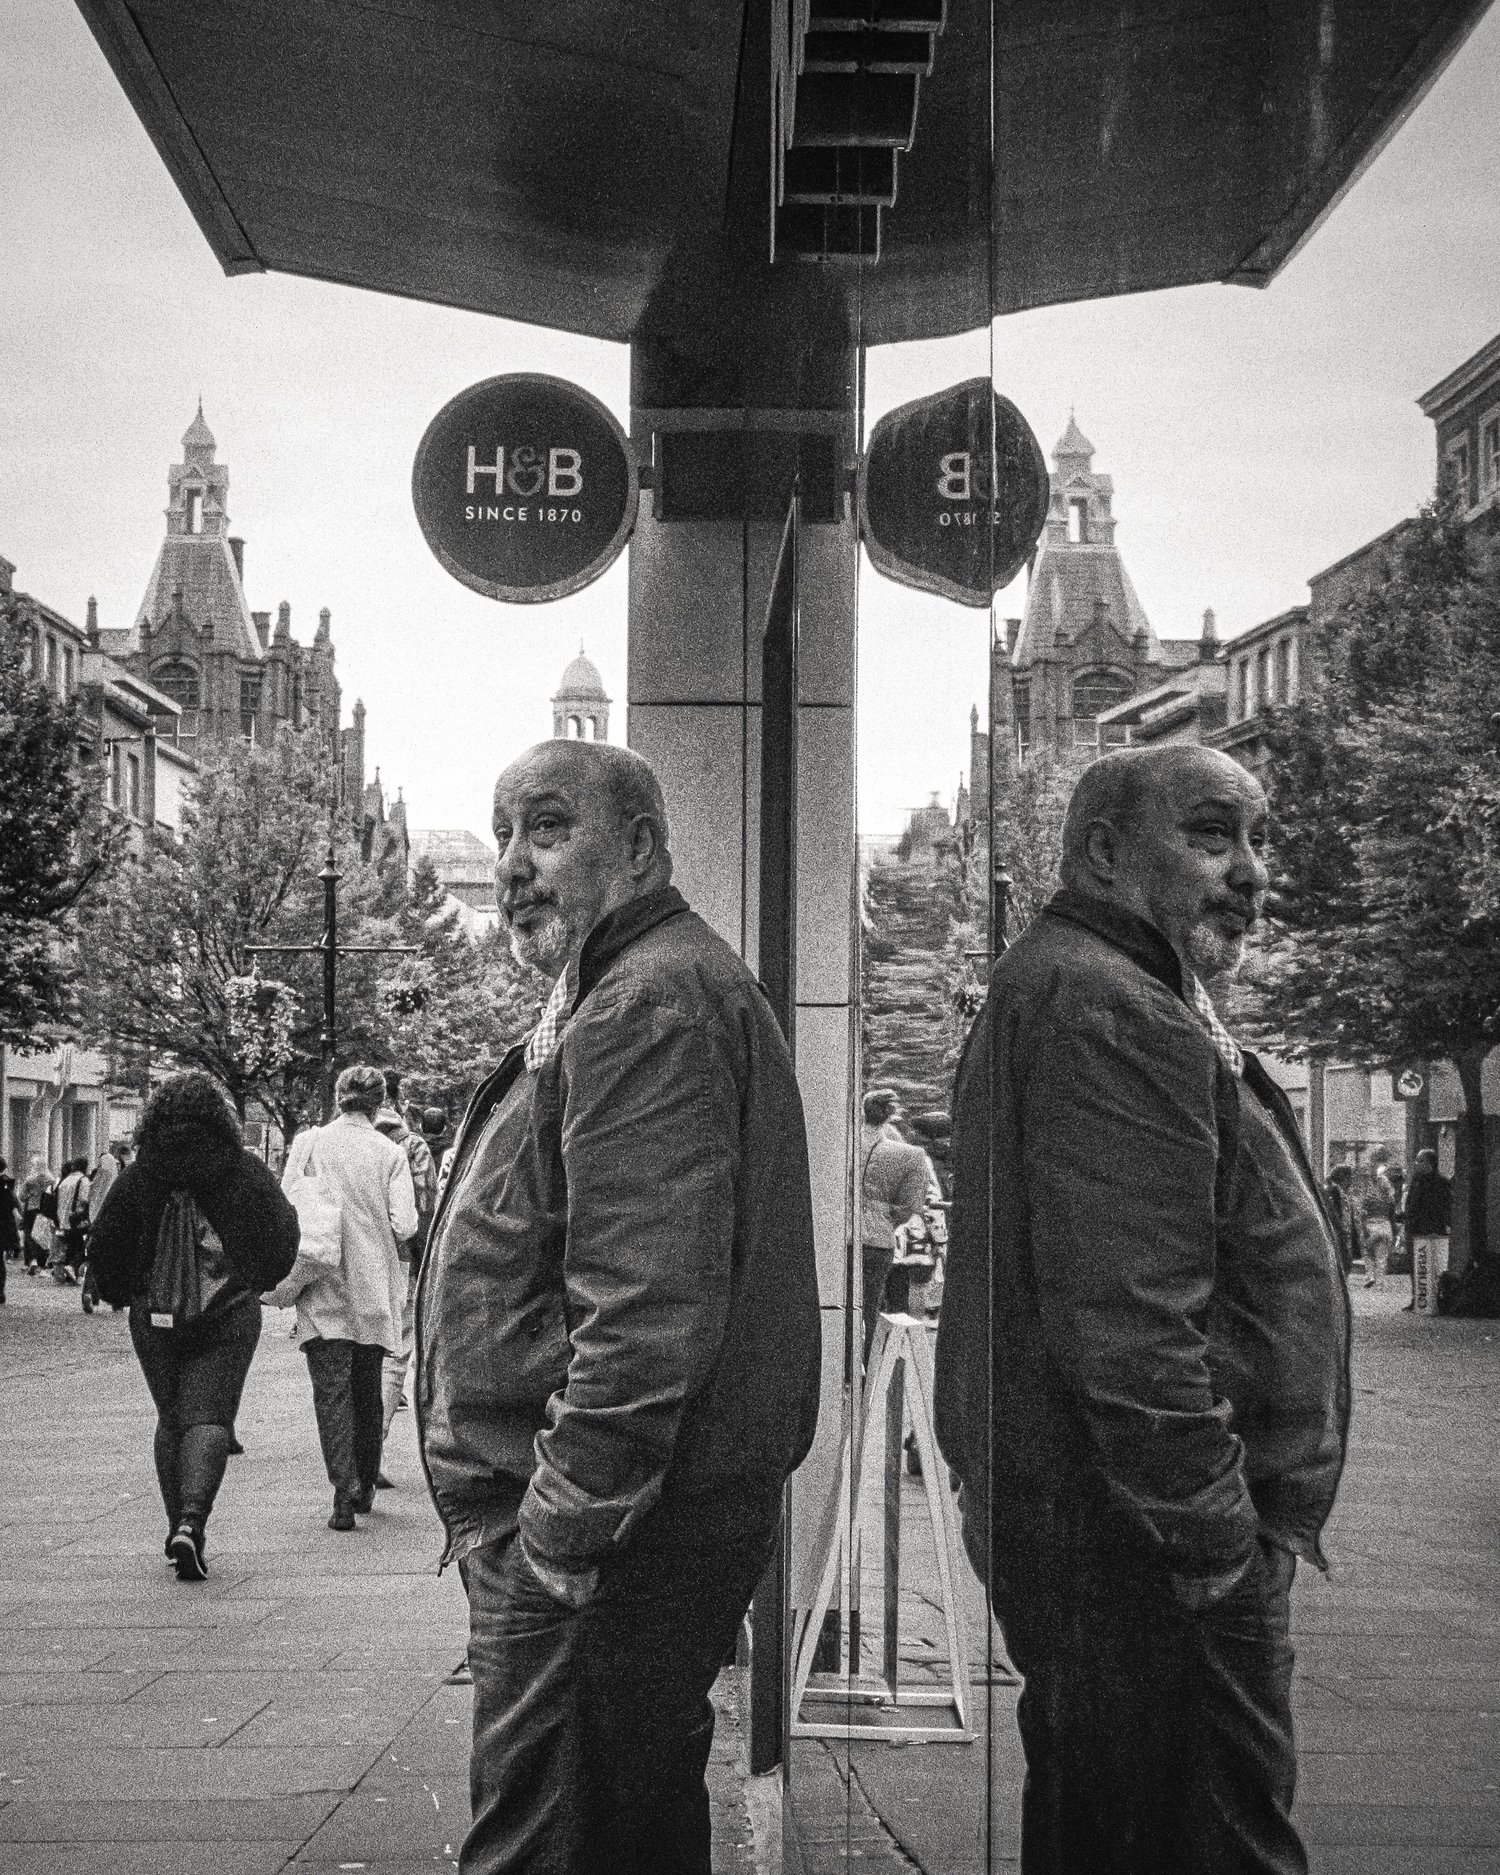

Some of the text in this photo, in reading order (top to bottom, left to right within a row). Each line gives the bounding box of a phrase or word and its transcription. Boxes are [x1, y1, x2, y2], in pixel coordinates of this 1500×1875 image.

[466, 445, 583, 496] H&B
[465, 505, 582, 523] SINCE 1870
